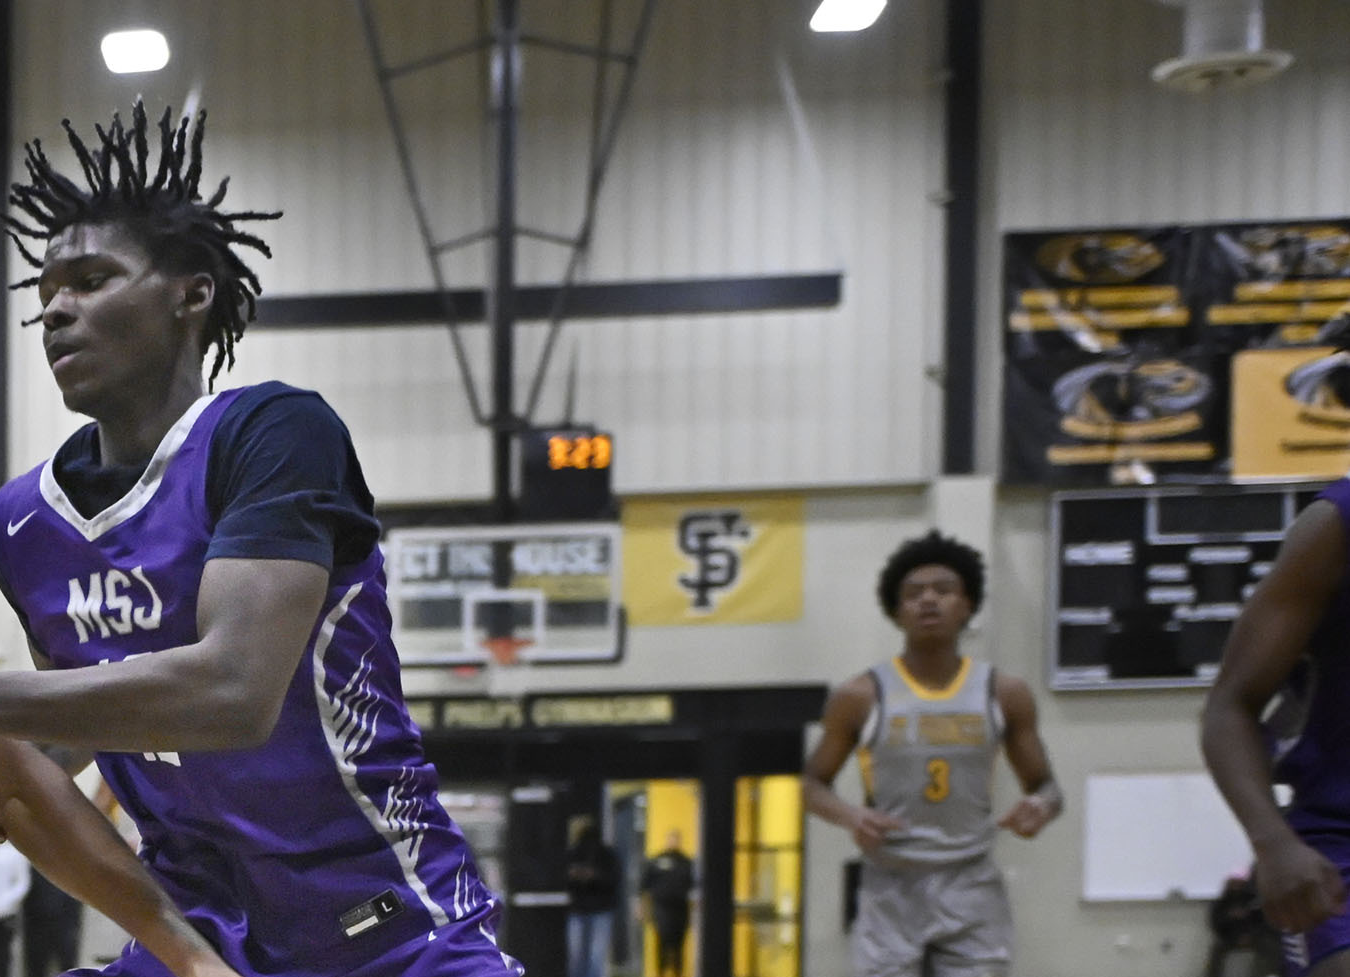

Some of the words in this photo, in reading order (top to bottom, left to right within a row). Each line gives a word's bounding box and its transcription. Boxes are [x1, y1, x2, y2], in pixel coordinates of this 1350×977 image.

[66, 565, 163, 644] MSJ
[925, 758, 950, 804] 3
[381, 901, 393, 913] L
